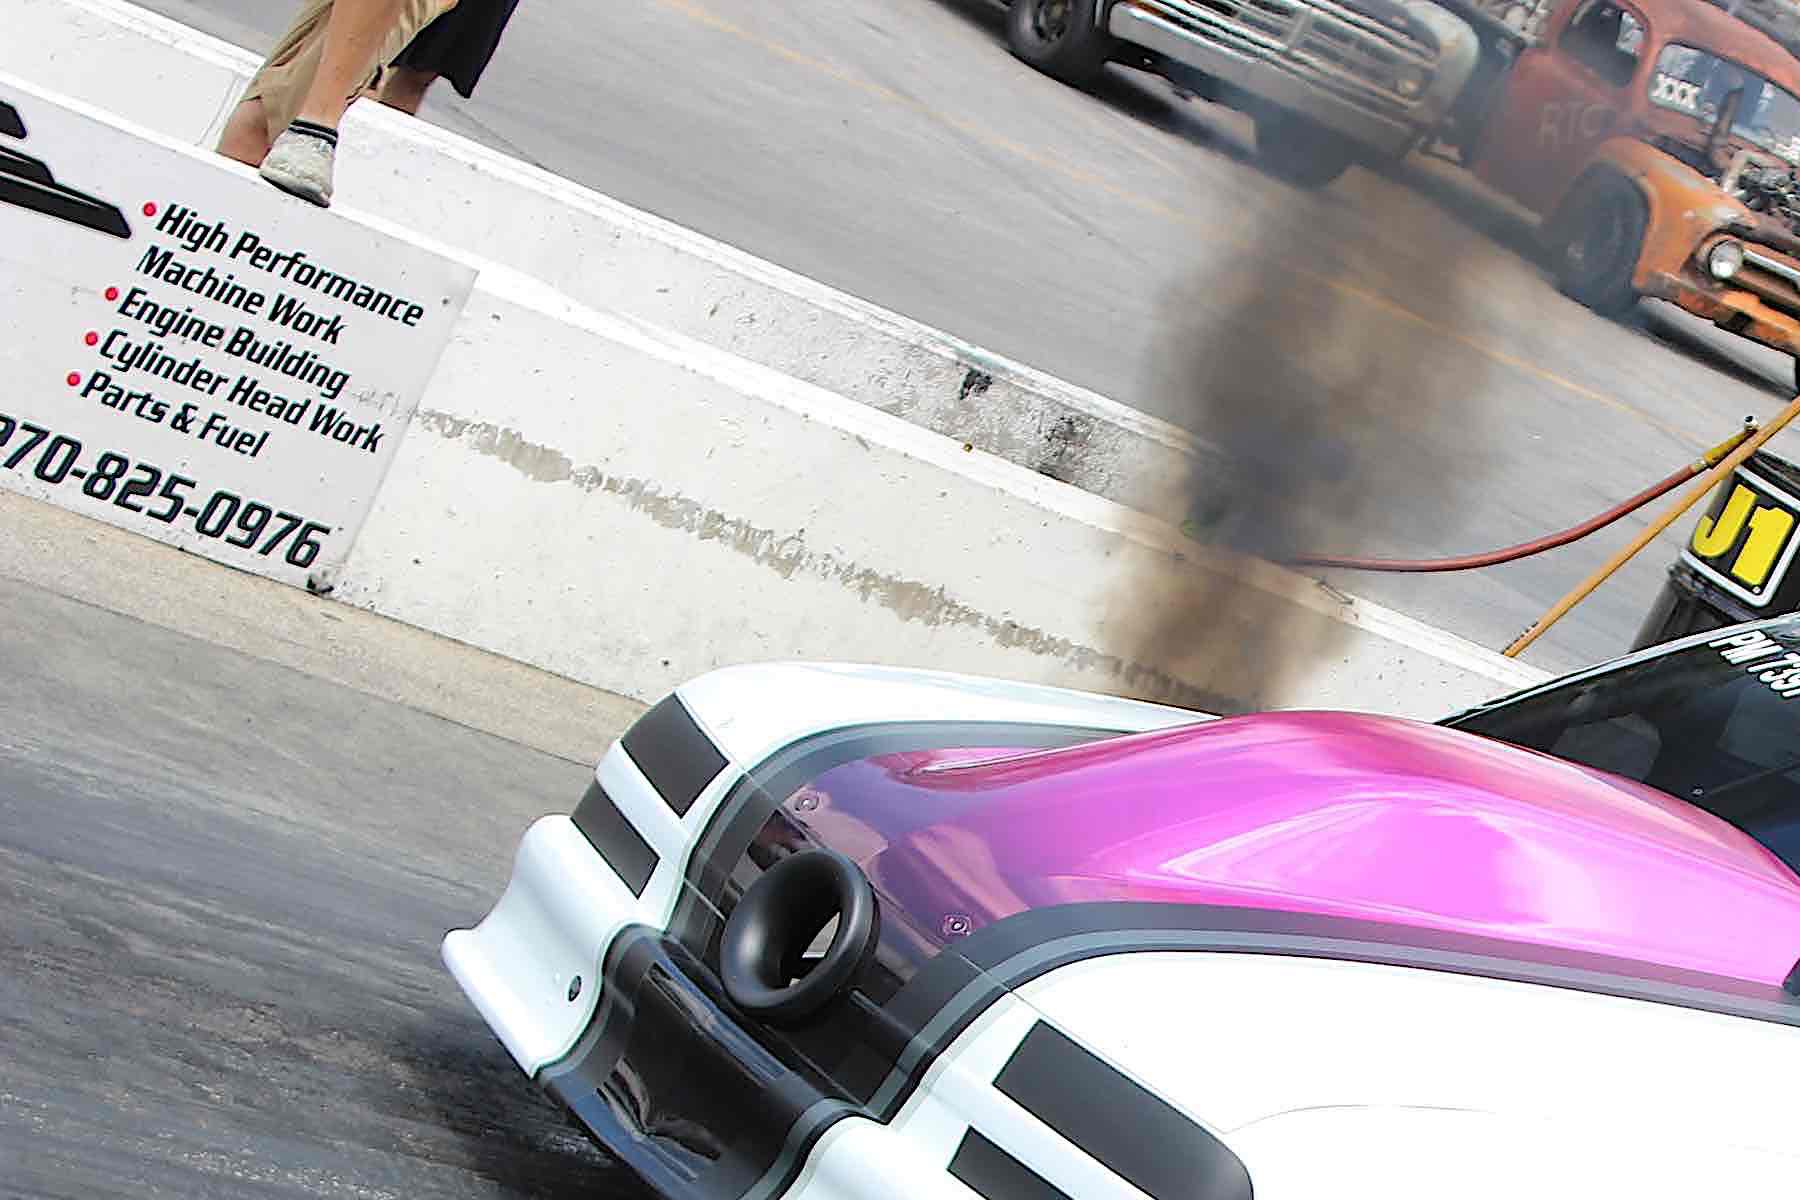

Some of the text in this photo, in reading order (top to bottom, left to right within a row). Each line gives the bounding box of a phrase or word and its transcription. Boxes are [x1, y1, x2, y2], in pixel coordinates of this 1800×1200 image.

[136, 244, 348, 346] Machine Work
[156, 203, 424, 328] High Performance
[99, 328, 386, 454] Cylinder Head Work
[117, 286, 351, 400] Engine Building
[80, 370, 271, 458] Parts & Fuel
[1692, 483, 1795, 585] J1
[1709, 629, 1784, 665] PM
